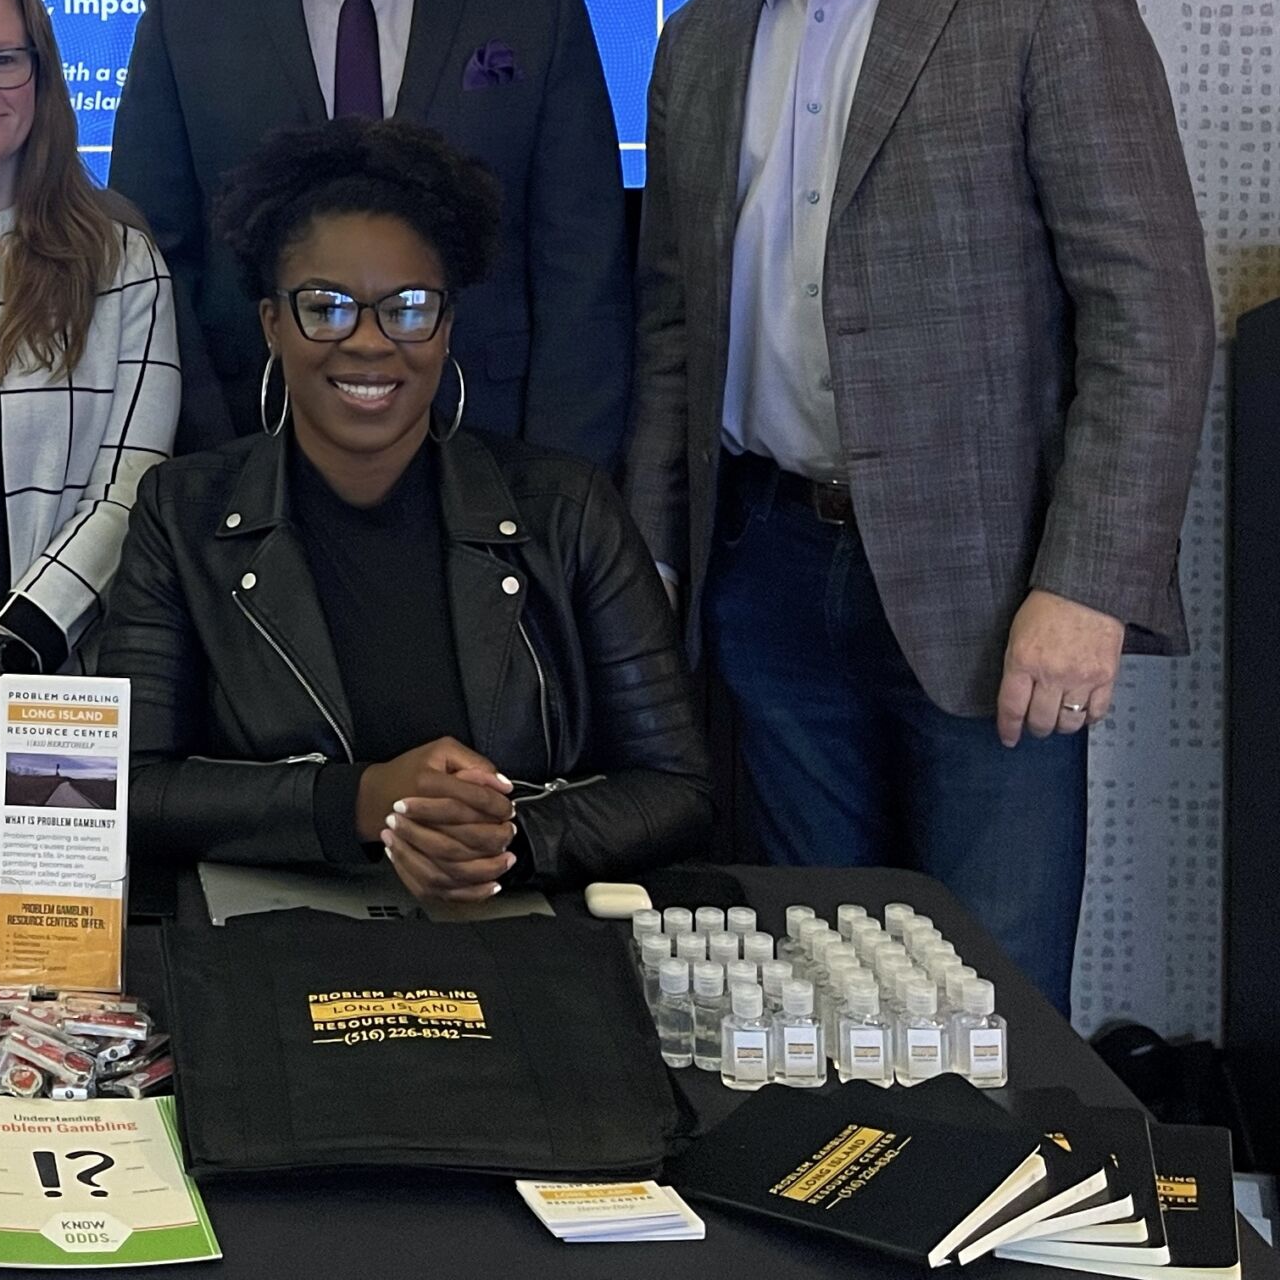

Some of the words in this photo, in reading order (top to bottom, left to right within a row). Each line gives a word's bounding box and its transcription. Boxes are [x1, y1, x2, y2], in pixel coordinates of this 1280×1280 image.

[62, 62, 90, 82] ith
[95, 70, 110, 82] a
[8, 691, 59, 701] PROBLEM
[63, 693, 119, 704] GAMBLING
[21, 708, 56, 719] LONG
[59, 710, 104, 722] ISLAND
[7, 726, 68, 737] RESOURCE
[73, 729, 119, 739] CENTER
[5, 815, 26, 825] WHAT
[27, 816, 35, 825] IS
[37, 816, 72, 827] PROBLEM
[21, 903, 55, 915] PROBLEM
[45, 916, 79, 928] CENTERS
[308, 990, 385, 1003] PROBLEM
[393, 989, 478, 1000] GAMBLING
[333, 1004, 385, 1015] LONG
[391, 1002, 458, 1014] ISLAND
[313, 1016, 409, 1032] RESOURCE
[417, 1017, 487, 1030] CENTER
[344, 1028, 385, 1046] (516)
[388, 1027, 460, 1039] 226-8342
[13, 1113, 101, 1123] Understanding
[56, 1120, 138, 1134] Gambling
[799, 1168, 831, 1192] LONG
[830, 1139, 866, 1168] ISLAND
[807, 1164, 861, 1205] RESOURCE
[859, 1133, 897, 1164] CENTER
[768, 1161, 814, 1195] PROBLEM
[837, 1179, 867, 1199] (516)
[61, 1220, 106, 1230] KNOW
